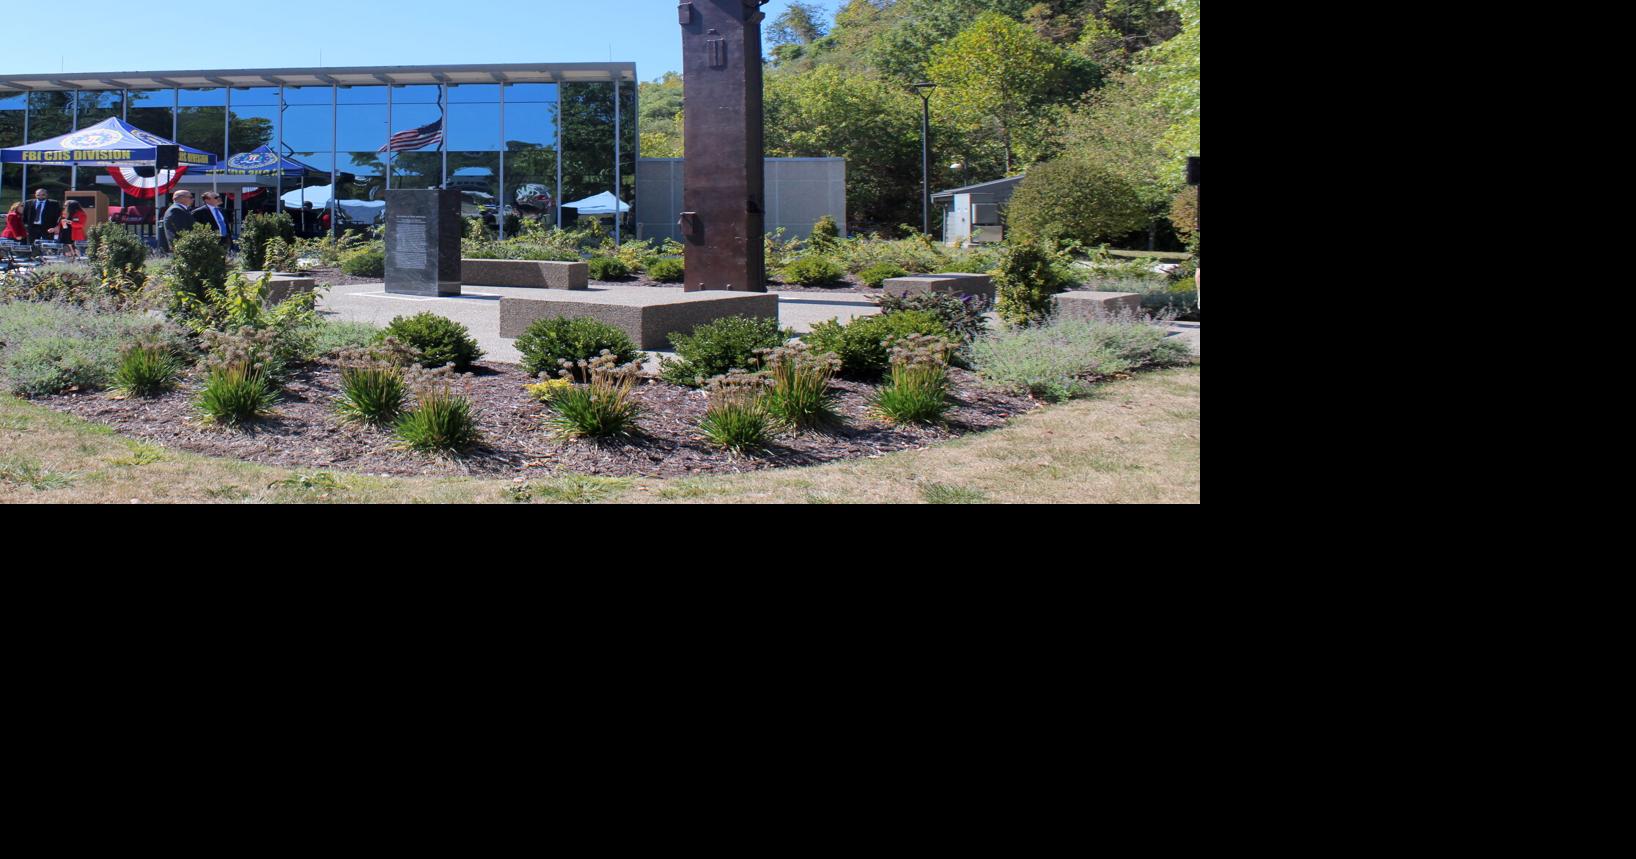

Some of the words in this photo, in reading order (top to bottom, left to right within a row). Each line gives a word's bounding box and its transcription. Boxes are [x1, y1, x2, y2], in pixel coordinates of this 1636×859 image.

[22, 151, 41, 161] FBI
[44, 150, 71, 161] CJIS
[73, 150, 131, 160] DIVISION
